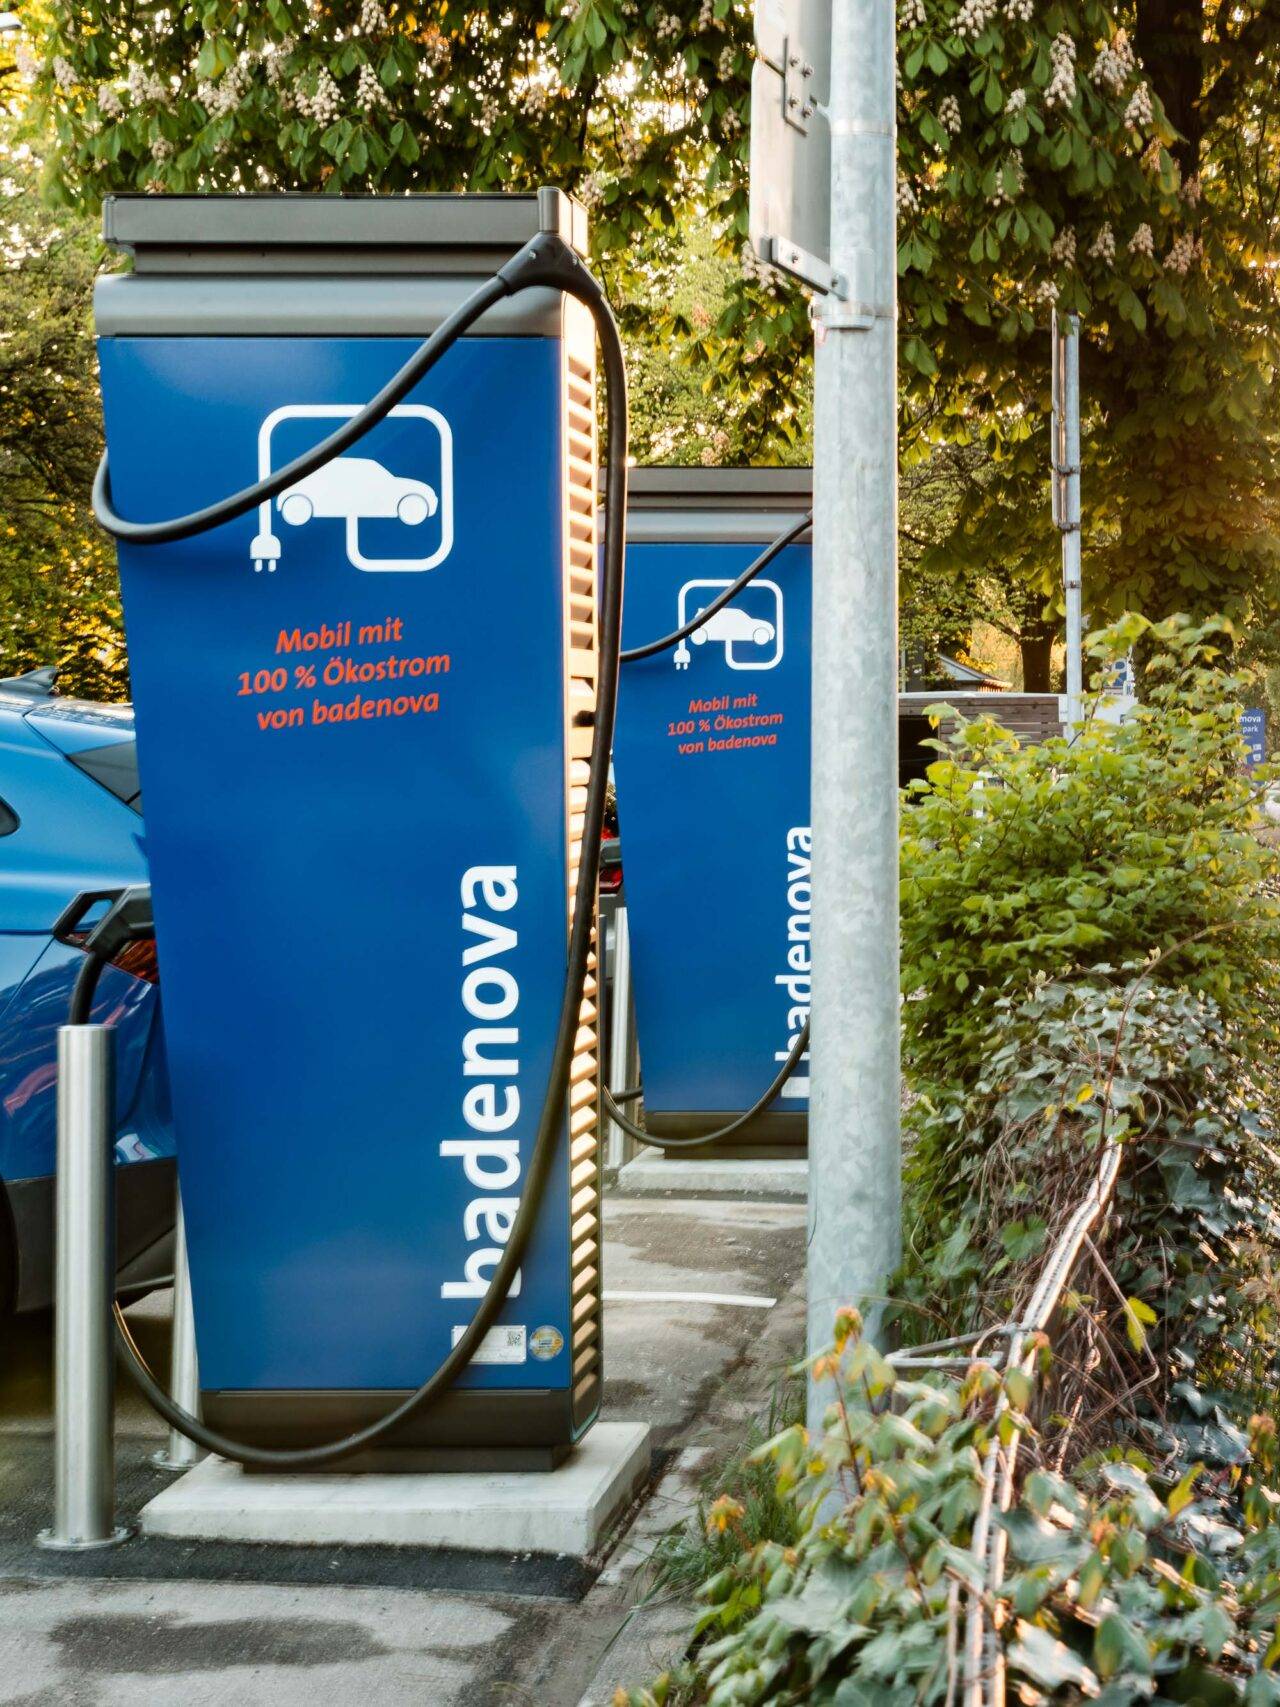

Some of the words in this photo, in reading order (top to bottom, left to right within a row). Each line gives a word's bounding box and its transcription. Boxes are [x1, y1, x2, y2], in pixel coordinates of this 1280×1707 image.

[275, 620, 351, 655] Mobil
[358, 616, 404, 646] mit
[237, 667, 288, 697] 100
[294, 664, 318, 689] %
[322, 654, 451, 687] Ökostrom
[256, 707, 304, 731] von
[311, 692, 440, 726] badenova
[688, 695, 730, 714] Mobil
[733, 692, 758, 709] mit
[668, 720, 695, 737] 100
[699, 718, 711, 732] %
[714, 712, 784, 731] Ökostrom
[1242, 725, 1259, 734] park
[678, 741, 704, 755] von
[708, 733, 778, 752] badenova
[440, 865, 522, 1299] badenova
